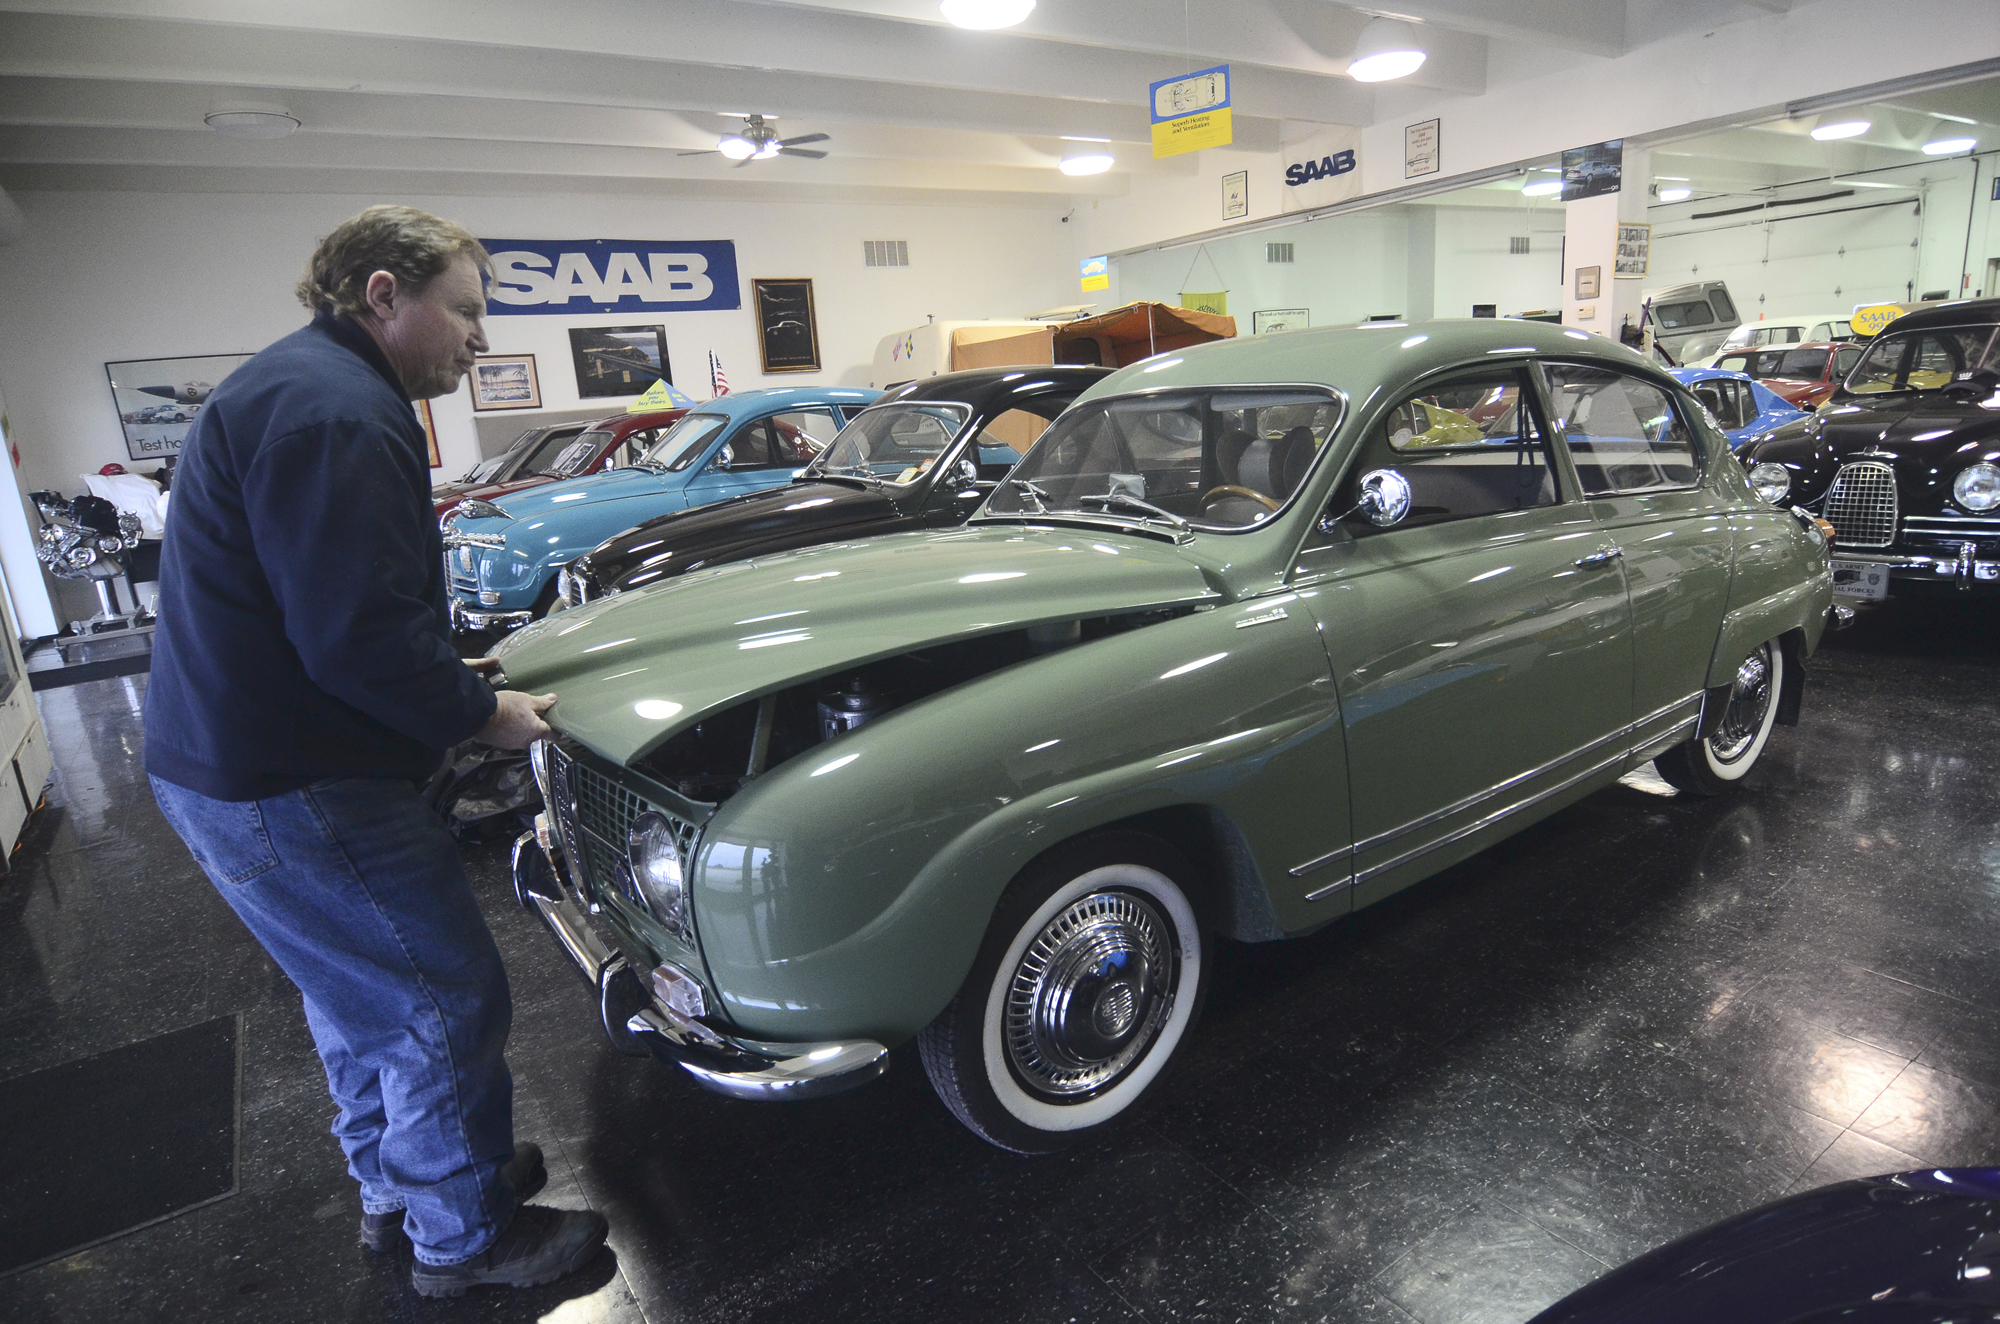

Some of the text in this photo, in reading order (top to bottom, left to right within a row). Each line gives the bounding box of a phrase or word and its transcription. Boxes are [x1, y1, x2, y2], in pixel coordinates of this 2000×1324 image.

[1172, 115, 1211, 128] Superb Heating
[1285, 149, 1356, 187] SAAB
[488, 251, 714, 306] SAAB
[1859, 311, 1897, 323] SAAB
[1868, 321, 1885, 333] 99
[136, 439, 162, 451] Test
